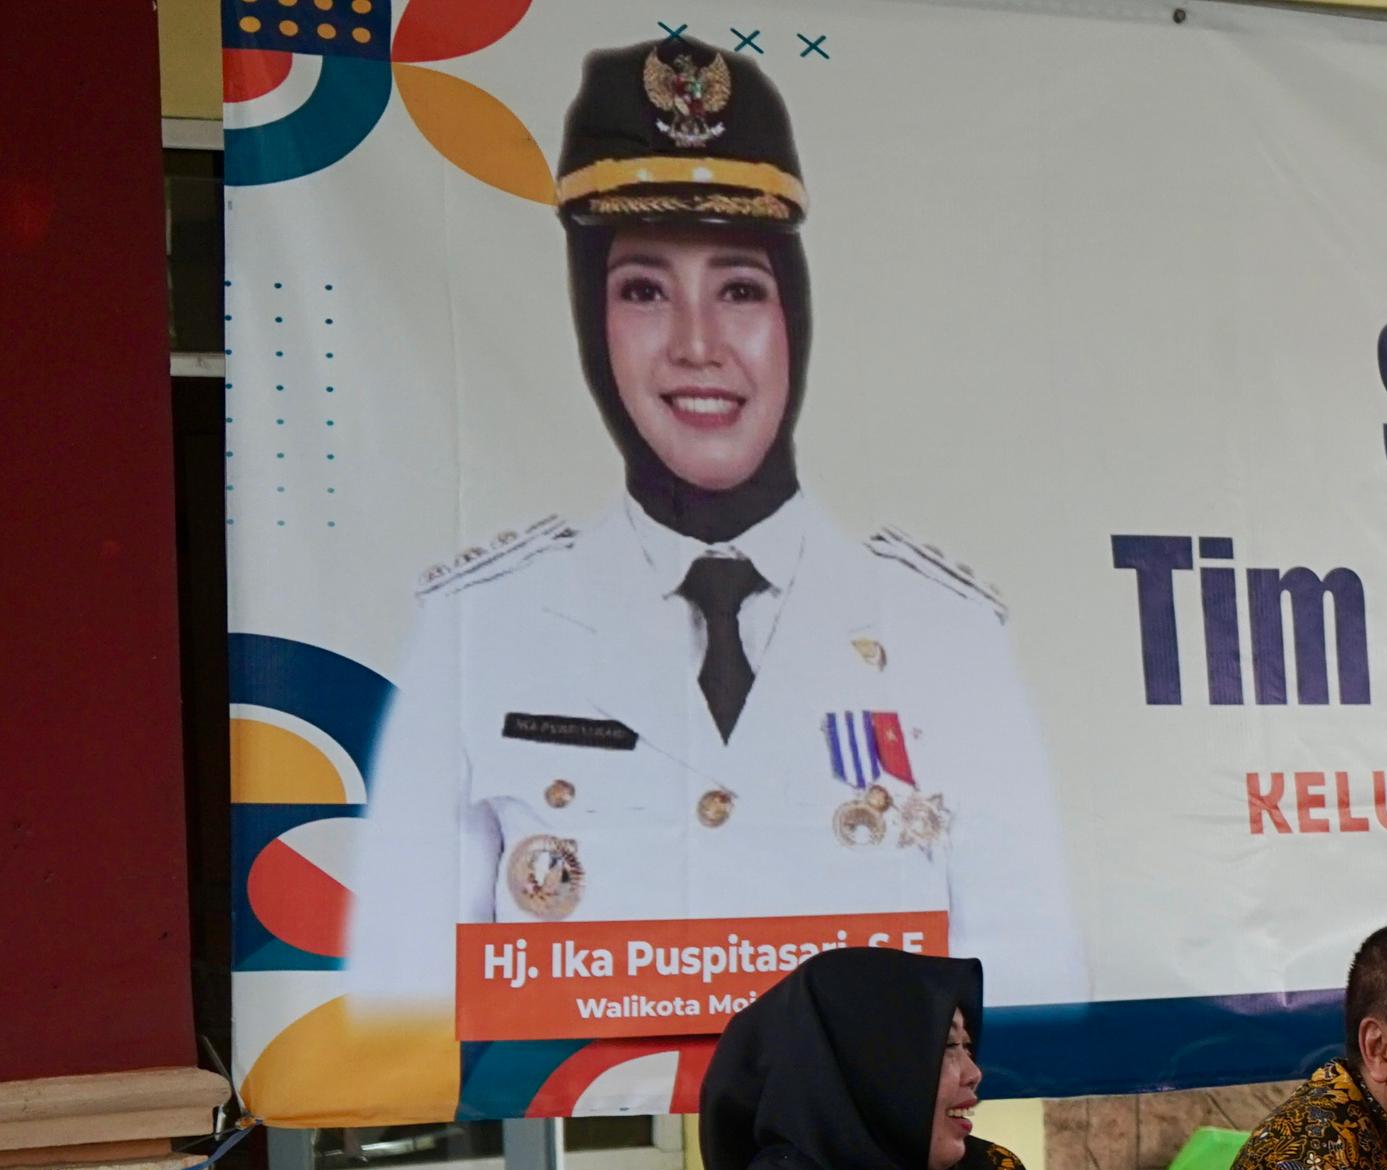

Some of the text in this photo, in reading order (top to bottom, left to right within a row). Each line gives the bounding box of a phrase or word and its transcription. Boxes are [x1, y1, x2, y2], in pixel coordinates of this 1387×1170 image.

[1111, 533, 1372, 707] Tim
[484, 938, 538, 988] Hj.
[551, 939, 614, 978] Ika
[576, 994, 700, 1019] Walikota
